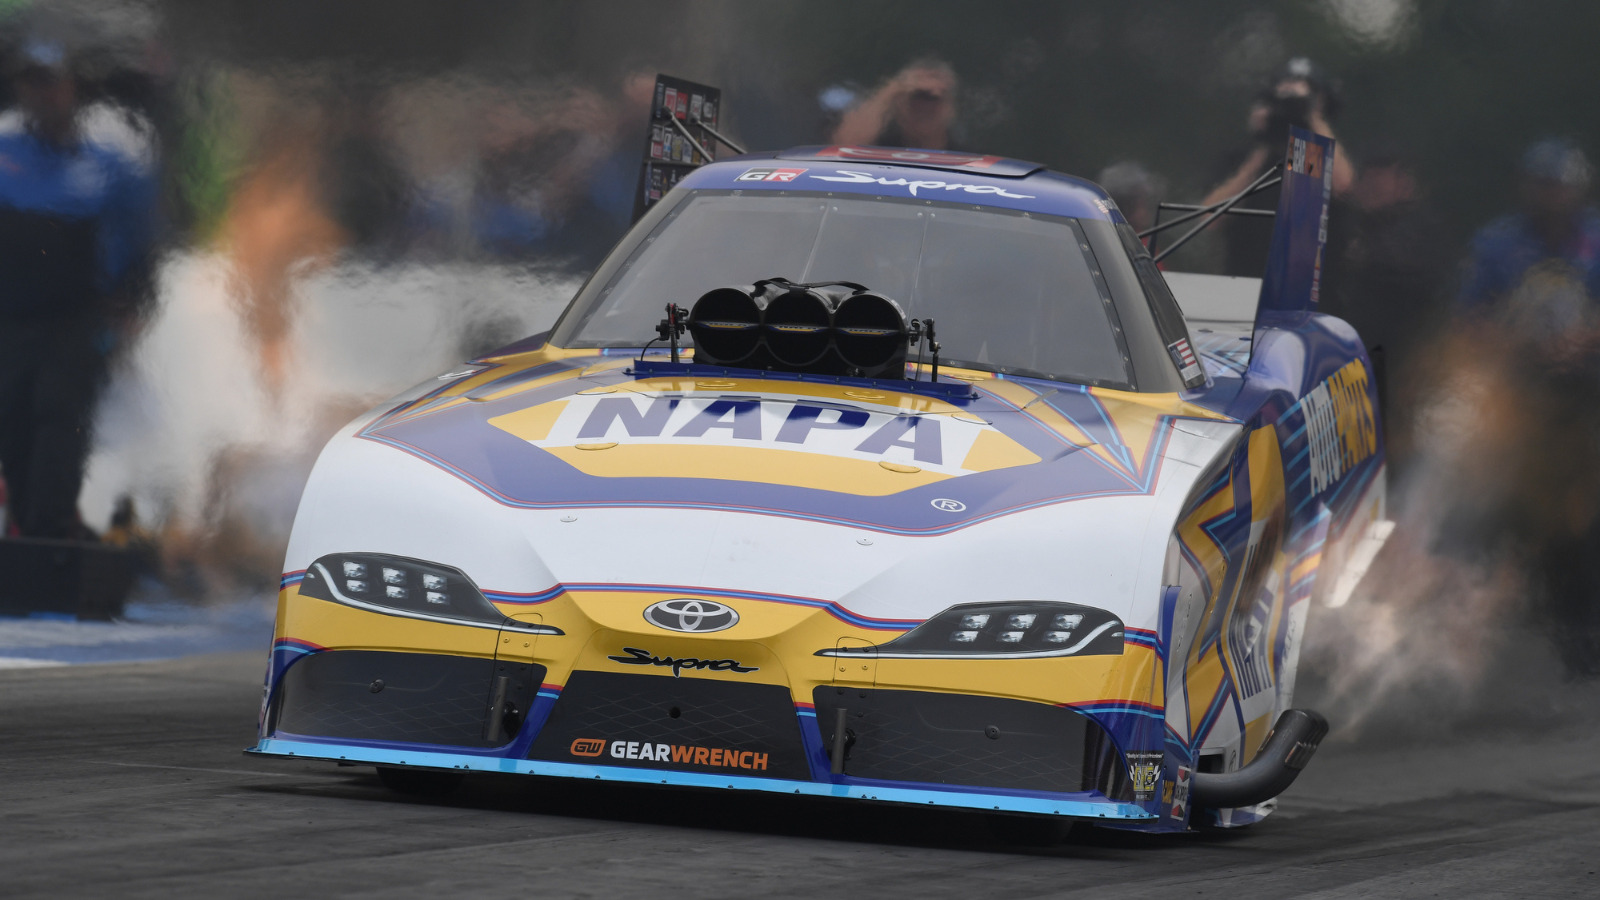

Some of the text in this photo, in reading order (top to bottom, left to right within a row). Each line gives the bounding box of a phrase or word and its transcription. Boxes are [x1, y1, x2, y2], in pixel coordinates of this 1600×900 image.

[738, 170, 1036, 199] GR Supra
[576, 394, 943, 465] NAPA
[607, 647, 760, 678] Supra
[610, 740, 769, 771] GEARWRENCH
